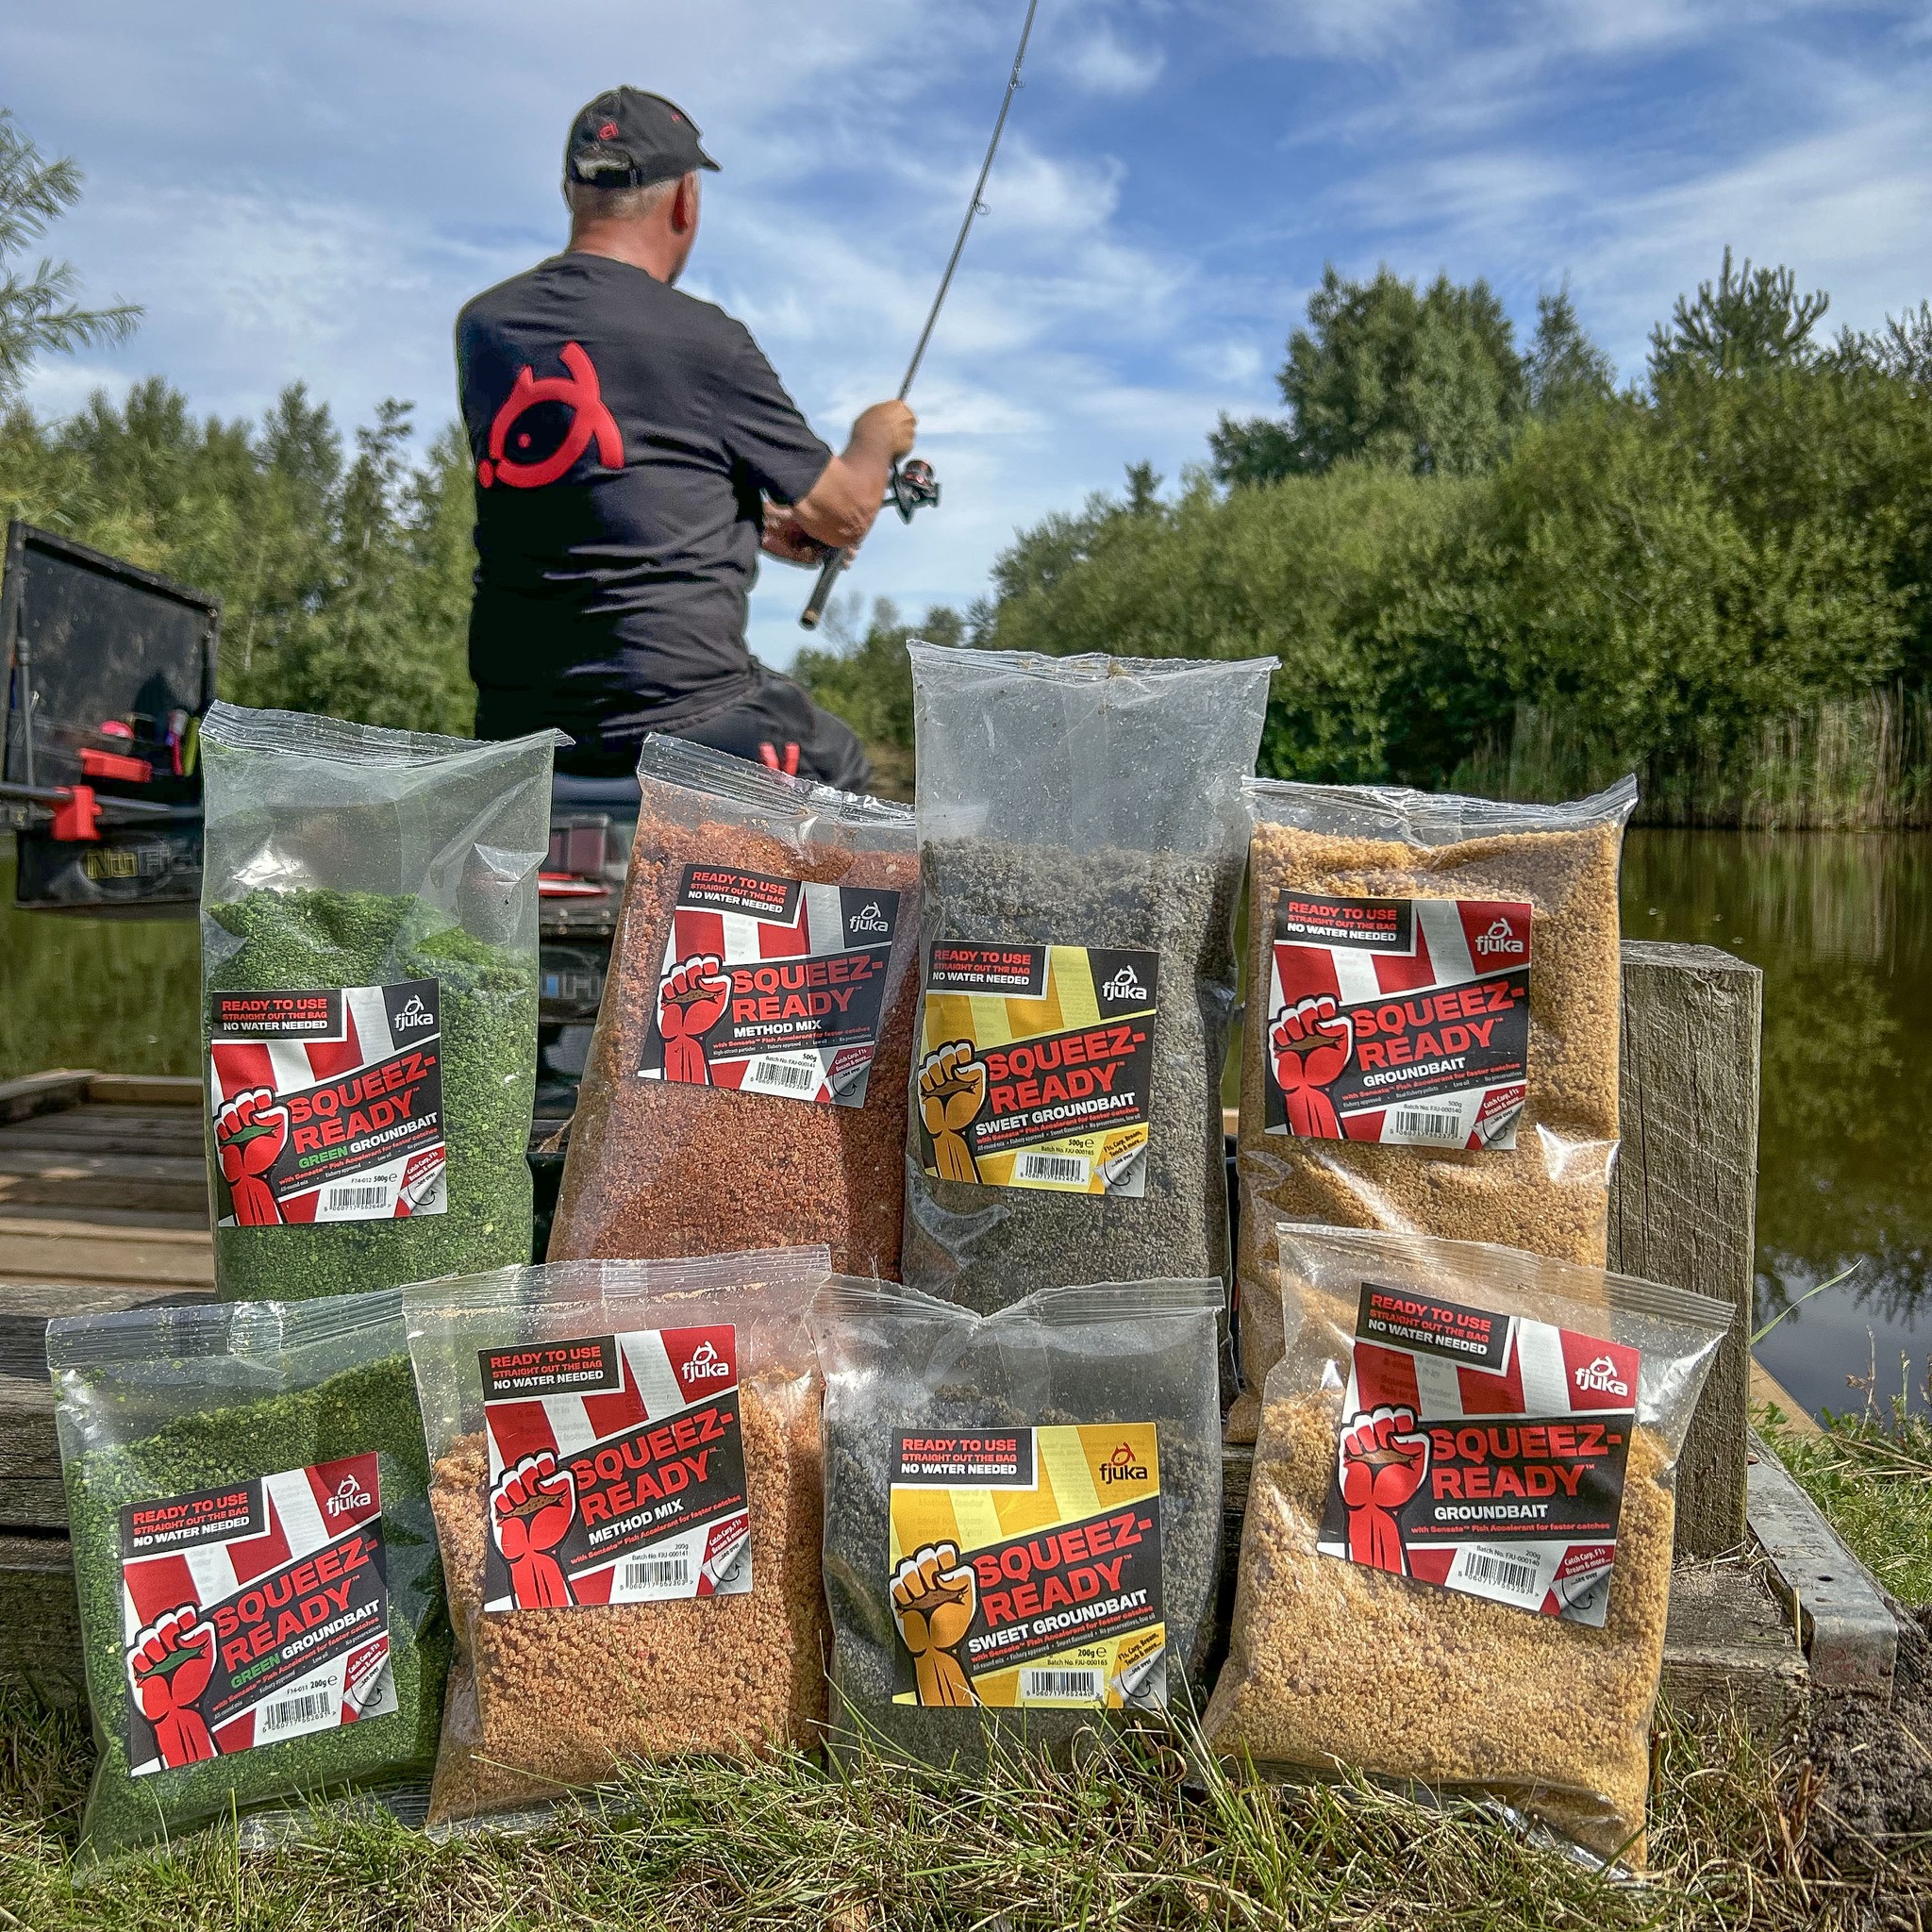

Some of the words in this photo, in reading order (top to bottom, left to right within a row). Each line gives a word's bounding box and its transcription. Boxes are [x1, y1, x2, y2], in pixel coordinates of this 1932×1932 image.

[691, 883, 731, 892] STRAIGHT
[729, 888, 749, 896] OUT
[750, 891, 766, 901] THE
[765, 893, 785, 905] BAG
[692, 872, 737, 884] READY
[740, 876, 758, 893] TO
[757, 882, 787, 898] USE
[688, 891, 703, 899] NO
[704, 891, 741, 905] WATER
[741, 898, 783, 913] NEEDED
[1288, 901, 1340, 917] READY
[1343, 908, 1364, 920] TO
[1366, 908, 1396, 921] USE
[849, 916, 889, 932] fjuka
[1287, 923, 1306, 932] NO
[1306, 924, 1348, 938] WATER
[1349, 930, 1396, 941] NEEDED
[1289, 914, 1334, 924] STRAIGHT
[1374, 922, 1397, 930] BAG
[1474, 935, 1524, 955] fjuka
[936, 950, 978, 962] READY
[981, 952, 1000, 963] TO
[1002, 953, 1031, 965] USE
[731, 956, 883, 995] SQUEEZ-
[933, 972, 945, 980] NO
[947, 973, 984, 982] WATER
[986, 974, 1029, 985] NEEDED
[1102, 981, 1147, 1001] fjuka
[222, 1000, 270, 1011] READY
[273, 999, 293, 1010] TO
[293, 997, 326, 1011] USE
[1351, 981, 1524, 1038] SQUEEZ-
[223, 1012, 267, 1021] STRAIGHT
[306, 1010, 327, 1020] BAG
[241, 1022, 280, 1030] WATER
[282, 1020, 327, 1030] NEEDED
[394, 1012, 433, 1031] fjuka
[734, 1023, 793, 1038] METHOD
[795, 1020, 822, 1031] MIX
[803, 1053, 817, 1063] 500g
[985, 1025, 1146, 1081] SQUEEZ-
[1363, 1057, 1465, 1087] GROUNDBAIT
[288, 1052, 436, 1124] SQUEEZ-
[975, 1113, 1028, 1136] SWEET
[1032, 1091, 1135, 1124] GROUNDBAIT
[298, 1145, 348, 1168] GREEN
[350, 1112, 437, 1153] GROUNDBAIT
[1068, 1139, 1084, 1148] 500g
[1371, 1294, 1427, 1316] READY
[1432, 1307, 1455, 1323] TO
[1457, 1313, 1491, 1333] USE
[1370, 1309, 1421, 1327] STRAIGHT
[1421, 1320, 1442, 1332] OUT
[1445, 1325, 1465, 1337] THE
[1465, 1330, 1490, 1342] BAG
[1368, 1319, 1387, 1331] NO
[1389, 1324, 1433, 1343] WATER
[1435, 1335, 1488, 1355] NEEDED
[491, 1352, 542, 1368] READY
[546, 1349, 567, 1362] TO
[570, 1345, 601, 1360] USE
[492, 1366, 540, 1378] STRAIGHT
[541, 1364, 560, 1374] OUT
[562, 1361, 581, 1371] THE
[580, 1359, 603, 1369] BAG
[681, 1361, 729, 1383] fjuka
[493, 1379, 510, 1390] NO
[512, 1375, 555, 1388] WATER
[557, 1370, 604, 1383] NEEDED
[1575, 1368, 1628, 1396] fjuka
[573, 1407, 734, 1491] SQUEEZ-
[902, 1439, 957, 1452] READY
[960, 1439, 982, 1453] TO
[984, 1439, 1016, 1452] USE
[1429, 1424, 1623, 1464] SQUEEZ-
[901, 1463, 920, 1474] NO
[922, 1463, 966, 1474] WATER
[968, 1464, 1017, 1474] NEEDED
[902, 1453, 951, 1462] STRAIGHT
[952, 1454, 973, 1462] OUT
[975, 1454, 995, 1463] THE
[994, 1454, 1017, 1463] BAG
[1099, 1463, 1148, 1485] fjuka
[132, 1505, 189, 1524] READY
[192, 1499, 214, 1513] TO
[216, 1491, 247, 1508] USE
[325, 1492, 371, 1517] fjuka
[1435, 1504, 1548, 1520] GROUNDBAIT
[133, 1536, 153, 1547] NO
[154, 1526, 200, 1543] WATER
[201, 1516, 249, 1535] NEEDED
[134, 1519, 184, 1535] STRAIGHT
[185, 1514, 206, 1526] OUT
[208, 1510, 228, 1520] THE
[227, 1506, 249, 1518] BAG
[589, 1511, 653, 1545] METHOD
[654, 1498, 684, 1520] MIX
[973, 1512, 1152, 1588] SQUEEZ-
[1525, 1550, 1541, 1560] 200g
[217, 1537, 377, 1638] SQUEEZ-
[968, 1624, 1029, 1653] SWEET
[1033, 1589, 1147, 1635] GROUNDBAIT
[230, 1654, 281, 1689] GREEN
[282, 1599, 379, 1659] GROUNDBAIT
[1078, 1649, 1095, 1658] 200g
